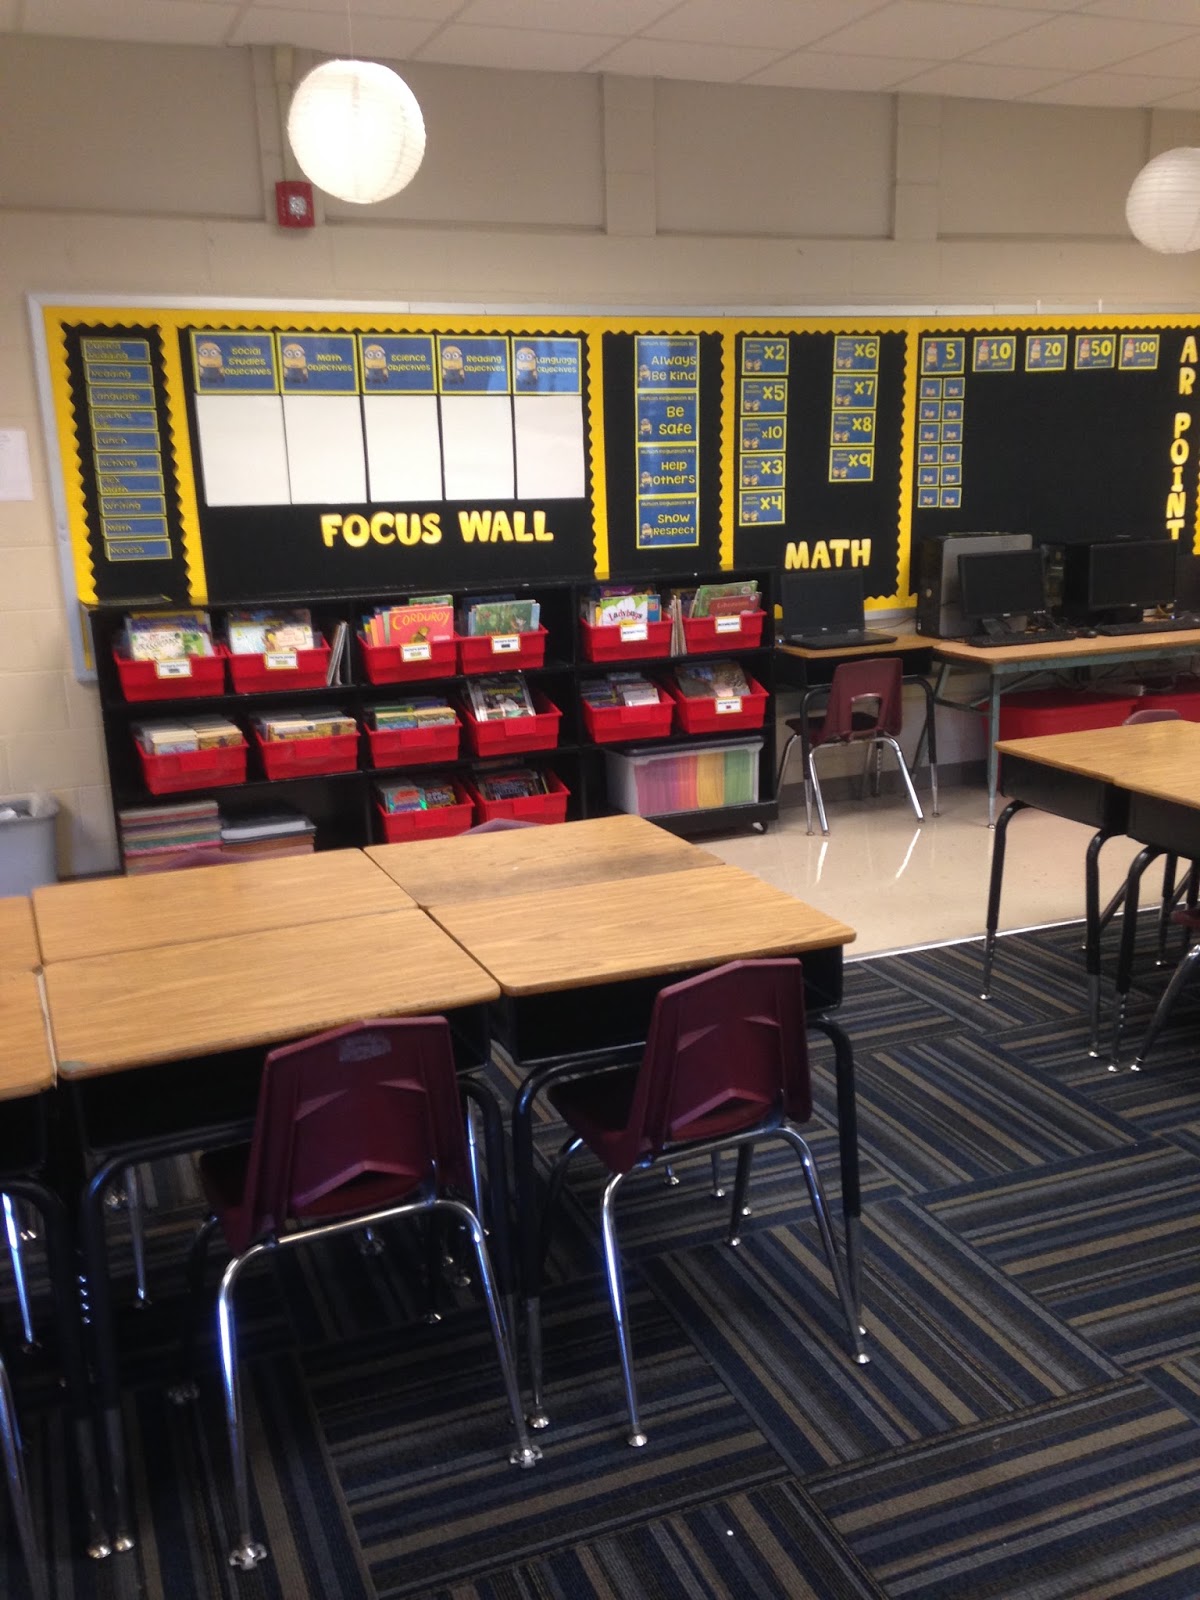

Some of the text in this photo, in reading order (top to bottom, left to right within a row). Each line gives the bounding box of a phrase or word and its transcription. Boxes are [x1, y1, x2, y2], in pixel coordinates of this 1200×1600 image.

[232, 347, 262, 356] Social
[946, 343, 956, 360] 5
[991, 344, 1012, 360] 10
[1044, 342, 1062, 357] 20
[1091, 340, 1112, 357] 50
[1135, 341, 1157, 354] 100
[228, 357, 267, 366] Studies
[316, 353, 343, 362] Math
[390, 354, 426, 362] Science
[466, 355, 503, 364] Reading
[535, 356, 577, 365] Language
[651, 355, 697, 367] Always
[306, 363, 353, 372] Objectives
[387, 363, 431, 372] Objectives
[463, 365, 506, 373] Objectives
[536, 366, 577, 374] Objectives
[1178, 335, 1198, 395] AR
[224, 367, 272, 376] Objectives
[651, 371, 697, 381] Be Kind
[666, 406, 684, 418] Be
[661, 461, 687, 471] Help
[653, 475, 696, 485] Others
[320, 510, 554, 548] FOCUS WALL
[653, 526, 695, 536] Respect
[785, 538, 872, 570] MATH
[608, 609, 643, 621] Ladybugs
[392, 611, 450, 630] CORDUROY
